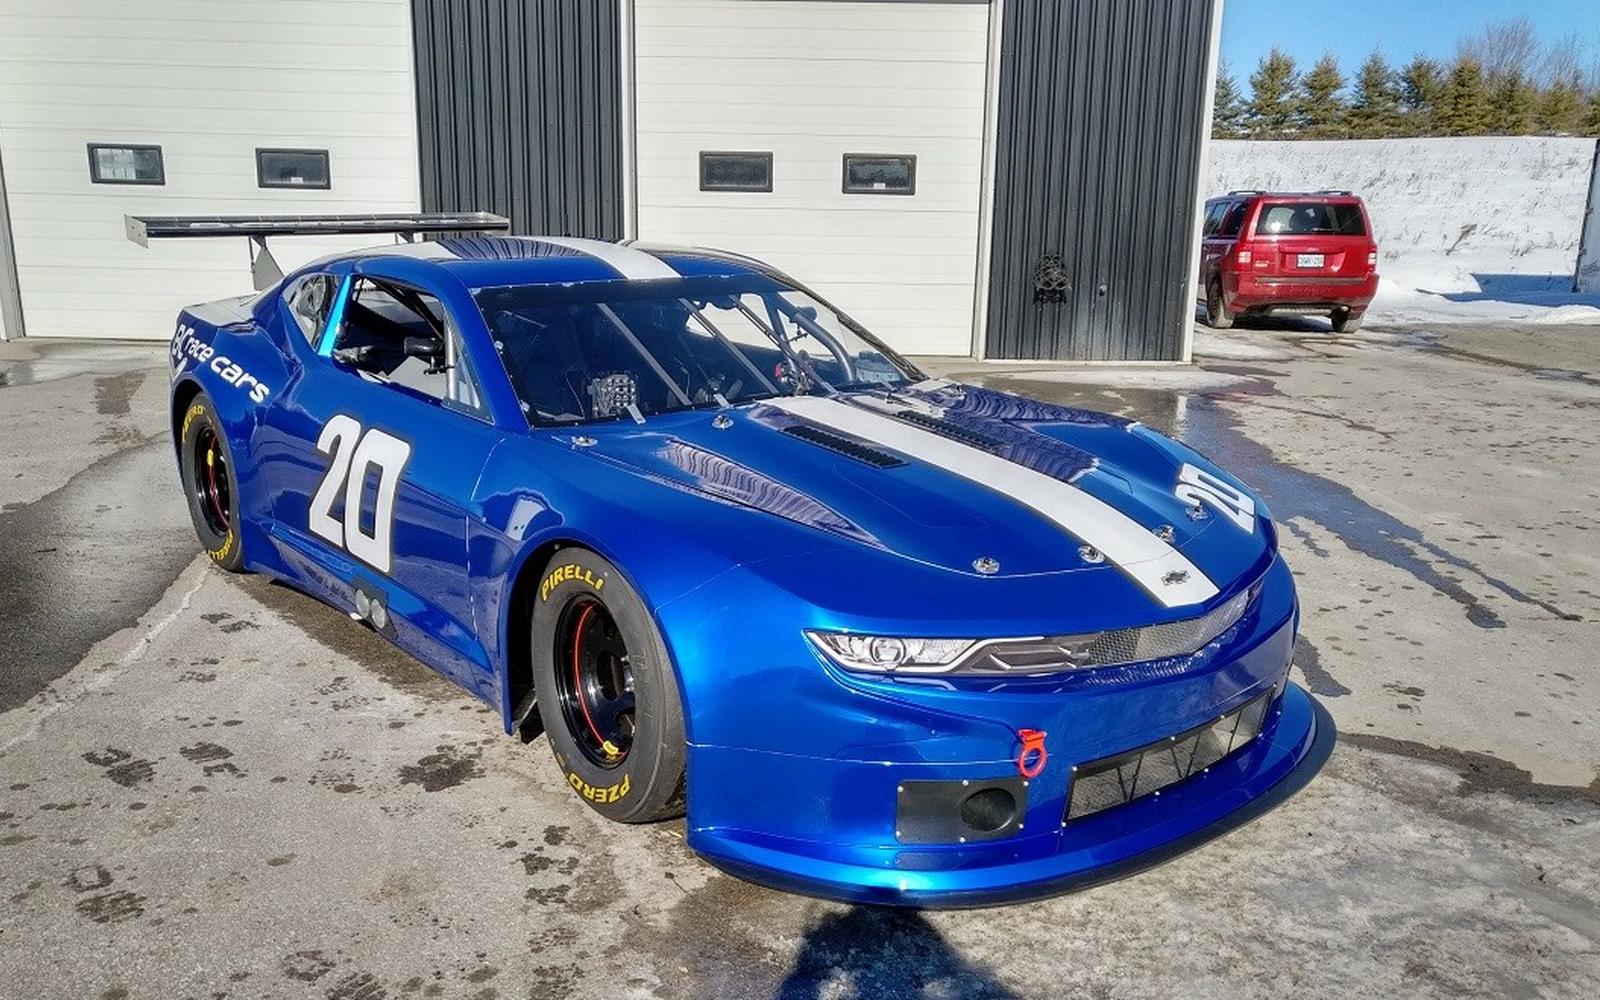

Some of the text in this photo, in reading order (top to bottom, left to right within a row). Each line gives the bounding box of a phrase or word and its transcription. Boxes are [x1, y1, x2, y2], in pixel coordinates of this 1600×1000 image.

[184, 336, 214, 362] race
[211, 356, 270, 403] cars
[308, 414, 411, 573] 20
[1174, 462, 1256, 535] 20
[541, 564, 604, 601] PIRELLI
[568, 773, 631, 803] PZERO
